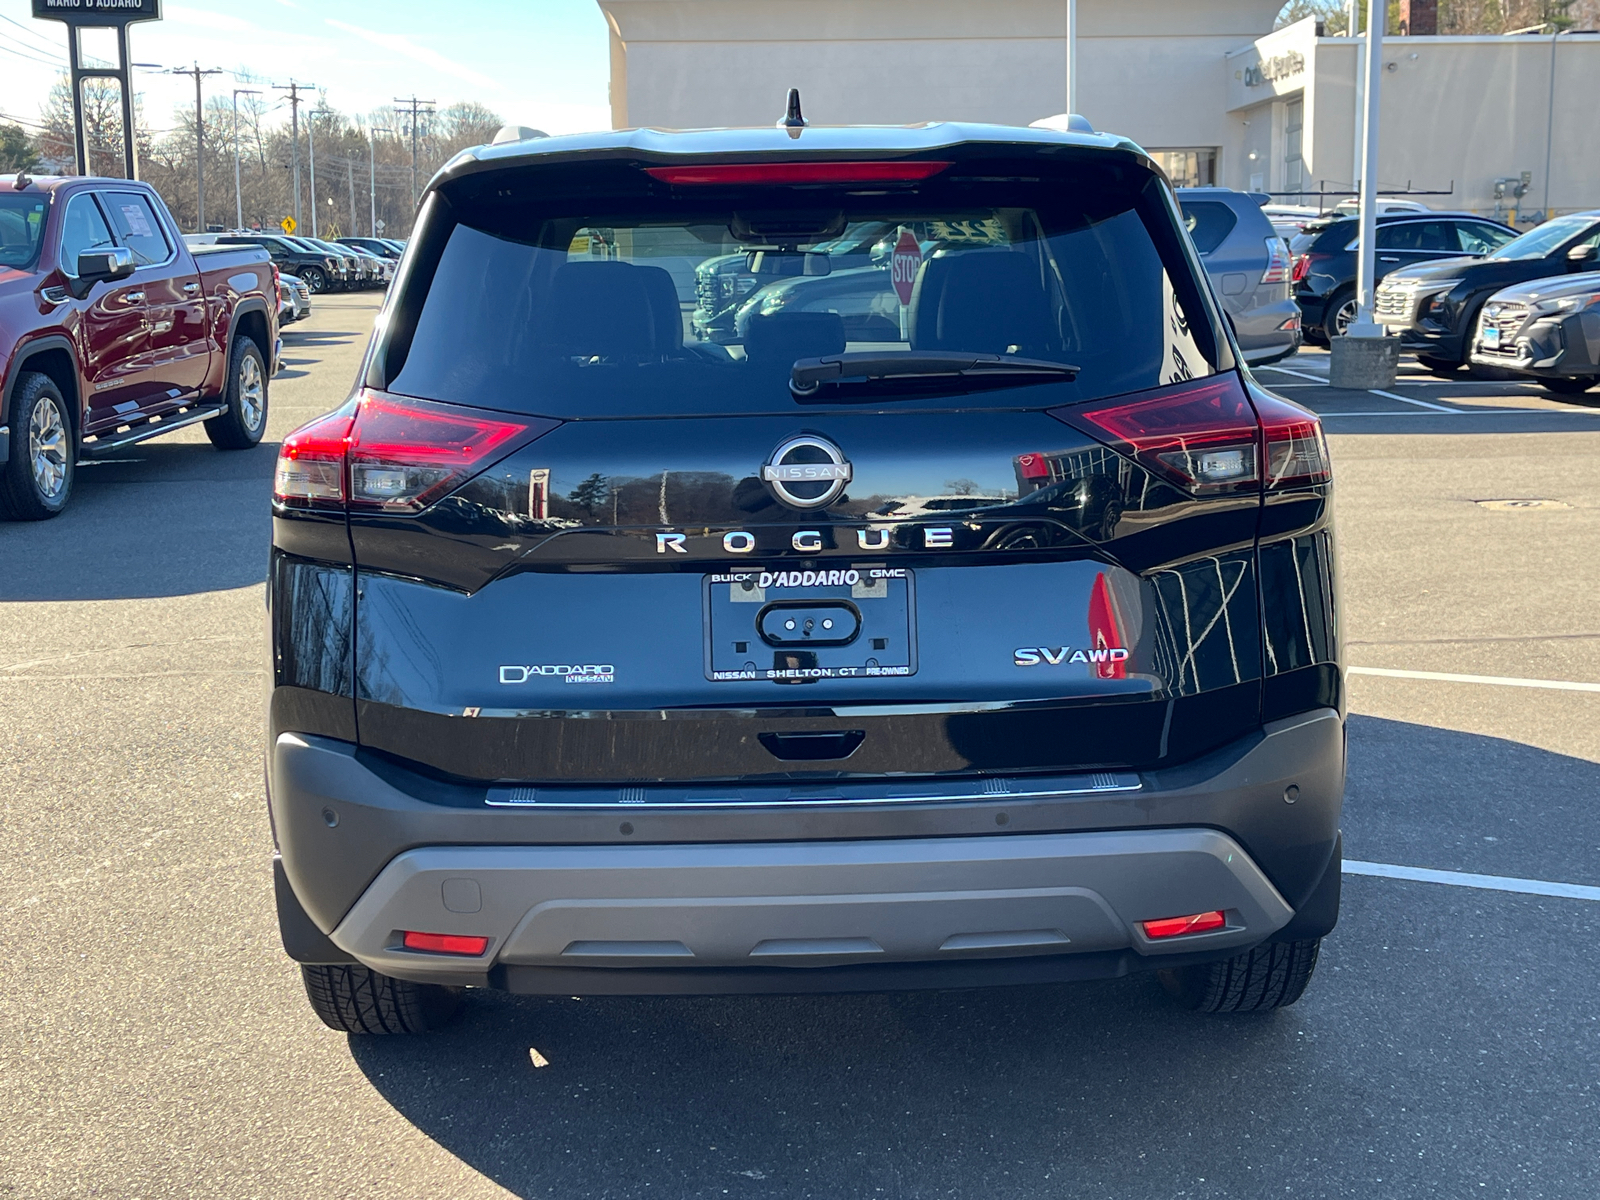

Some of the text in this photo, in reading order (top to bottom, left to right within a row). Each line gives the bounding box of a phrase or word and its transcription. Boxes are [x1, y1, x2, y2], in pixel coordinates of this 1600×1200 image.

[86, 0, 142, 8] DADDARIO
[894, 254, 921, 283] STOP
[767, 466, 848, 479] NISSAN
[655, 527, 954, 553] ROGUE
[711, 569, 906, 588] BUICK D'ADDARIO GMC
[1014, 646, 1129, 666] SV AWD
[565, 675, 614, 683] NISSAN
[713, 667, 909, 680] NISSAN SHELTON, CT PRE-OWNED
